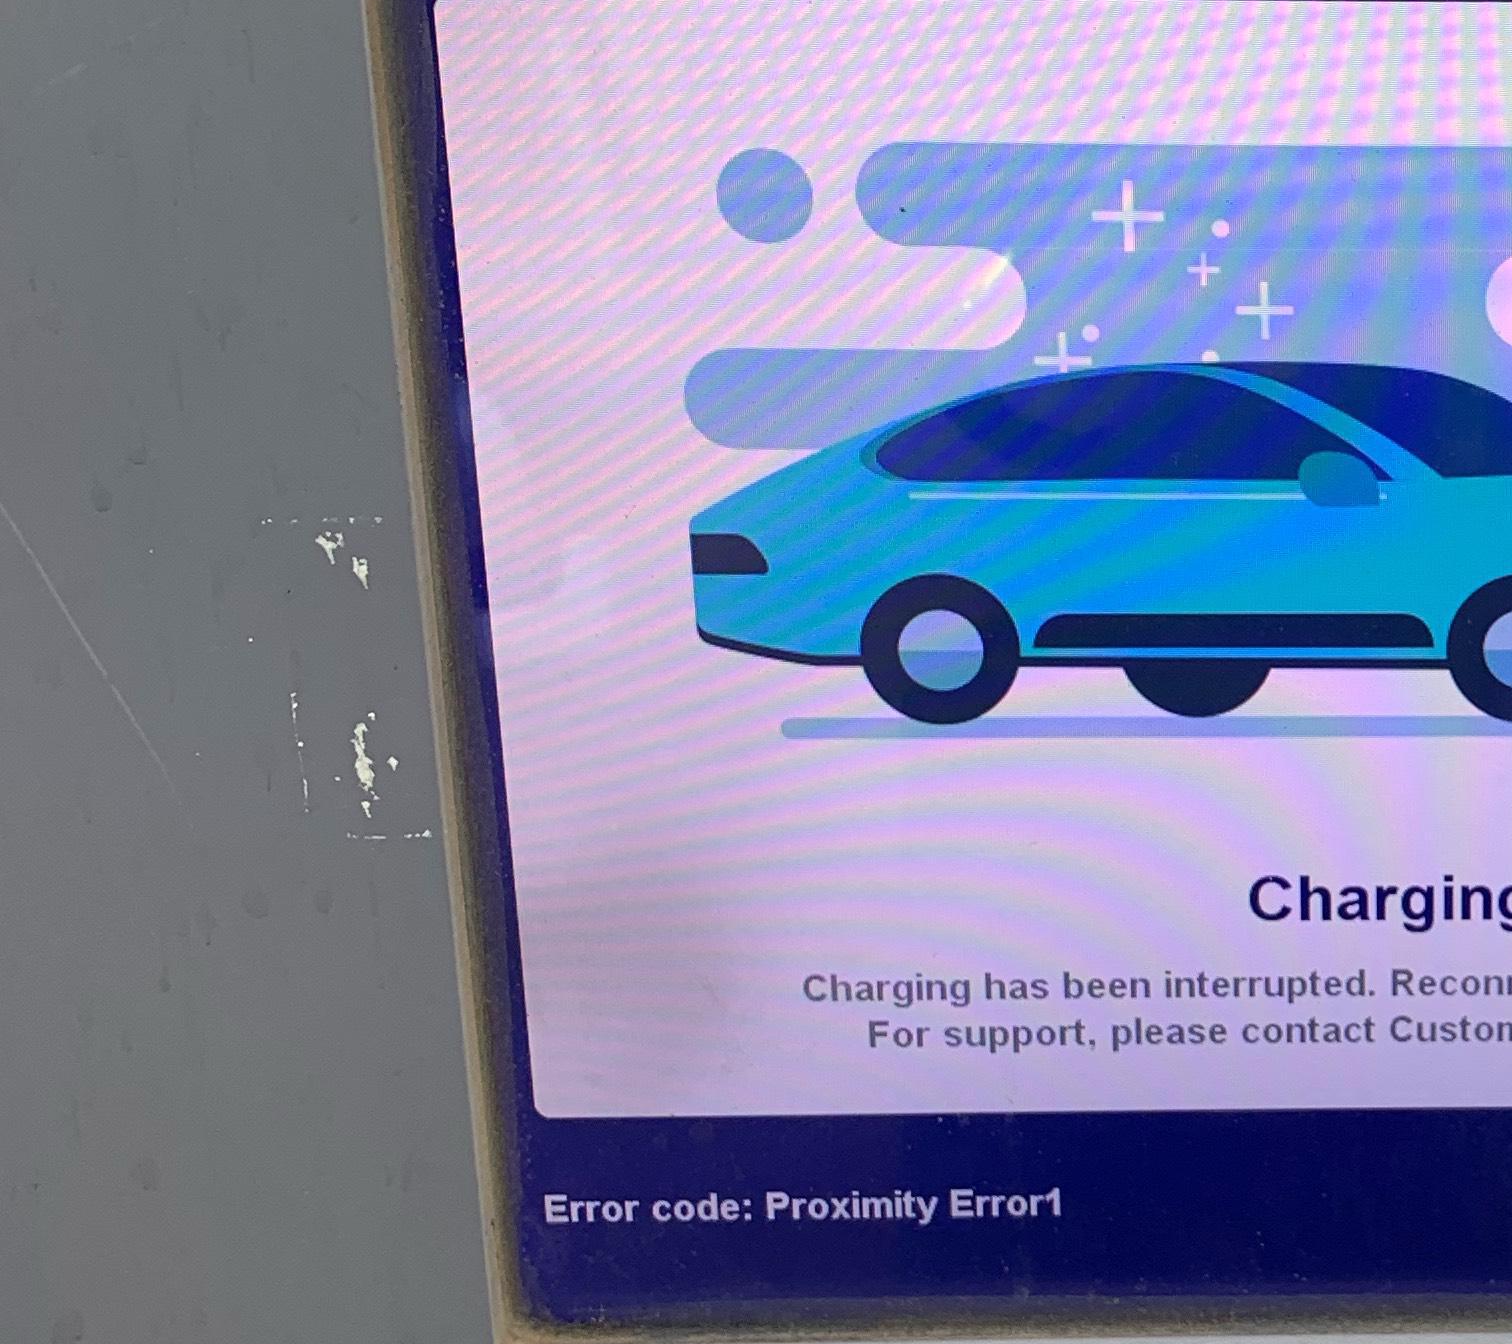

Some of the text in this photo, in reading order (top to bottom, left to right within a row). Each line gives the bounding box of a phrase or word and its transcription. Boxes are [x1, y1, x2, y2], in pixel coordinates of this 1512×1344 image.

[802, 972, 972, 1009] Charging
[984, 972, 1049, 1002] has
[1062, 971, 1151, 1001] been
[1164, 969, 1376, 1005] interrupted.
[868, 1019, 931, 1049] For
[943, 1019, 1097, 1053] support,
[1111, 1017, 1228, 1053] please
[1241, 1016, 1376, 1045] contact
[543, 1187, 1063, 1226] Error code: Proximity Error1
